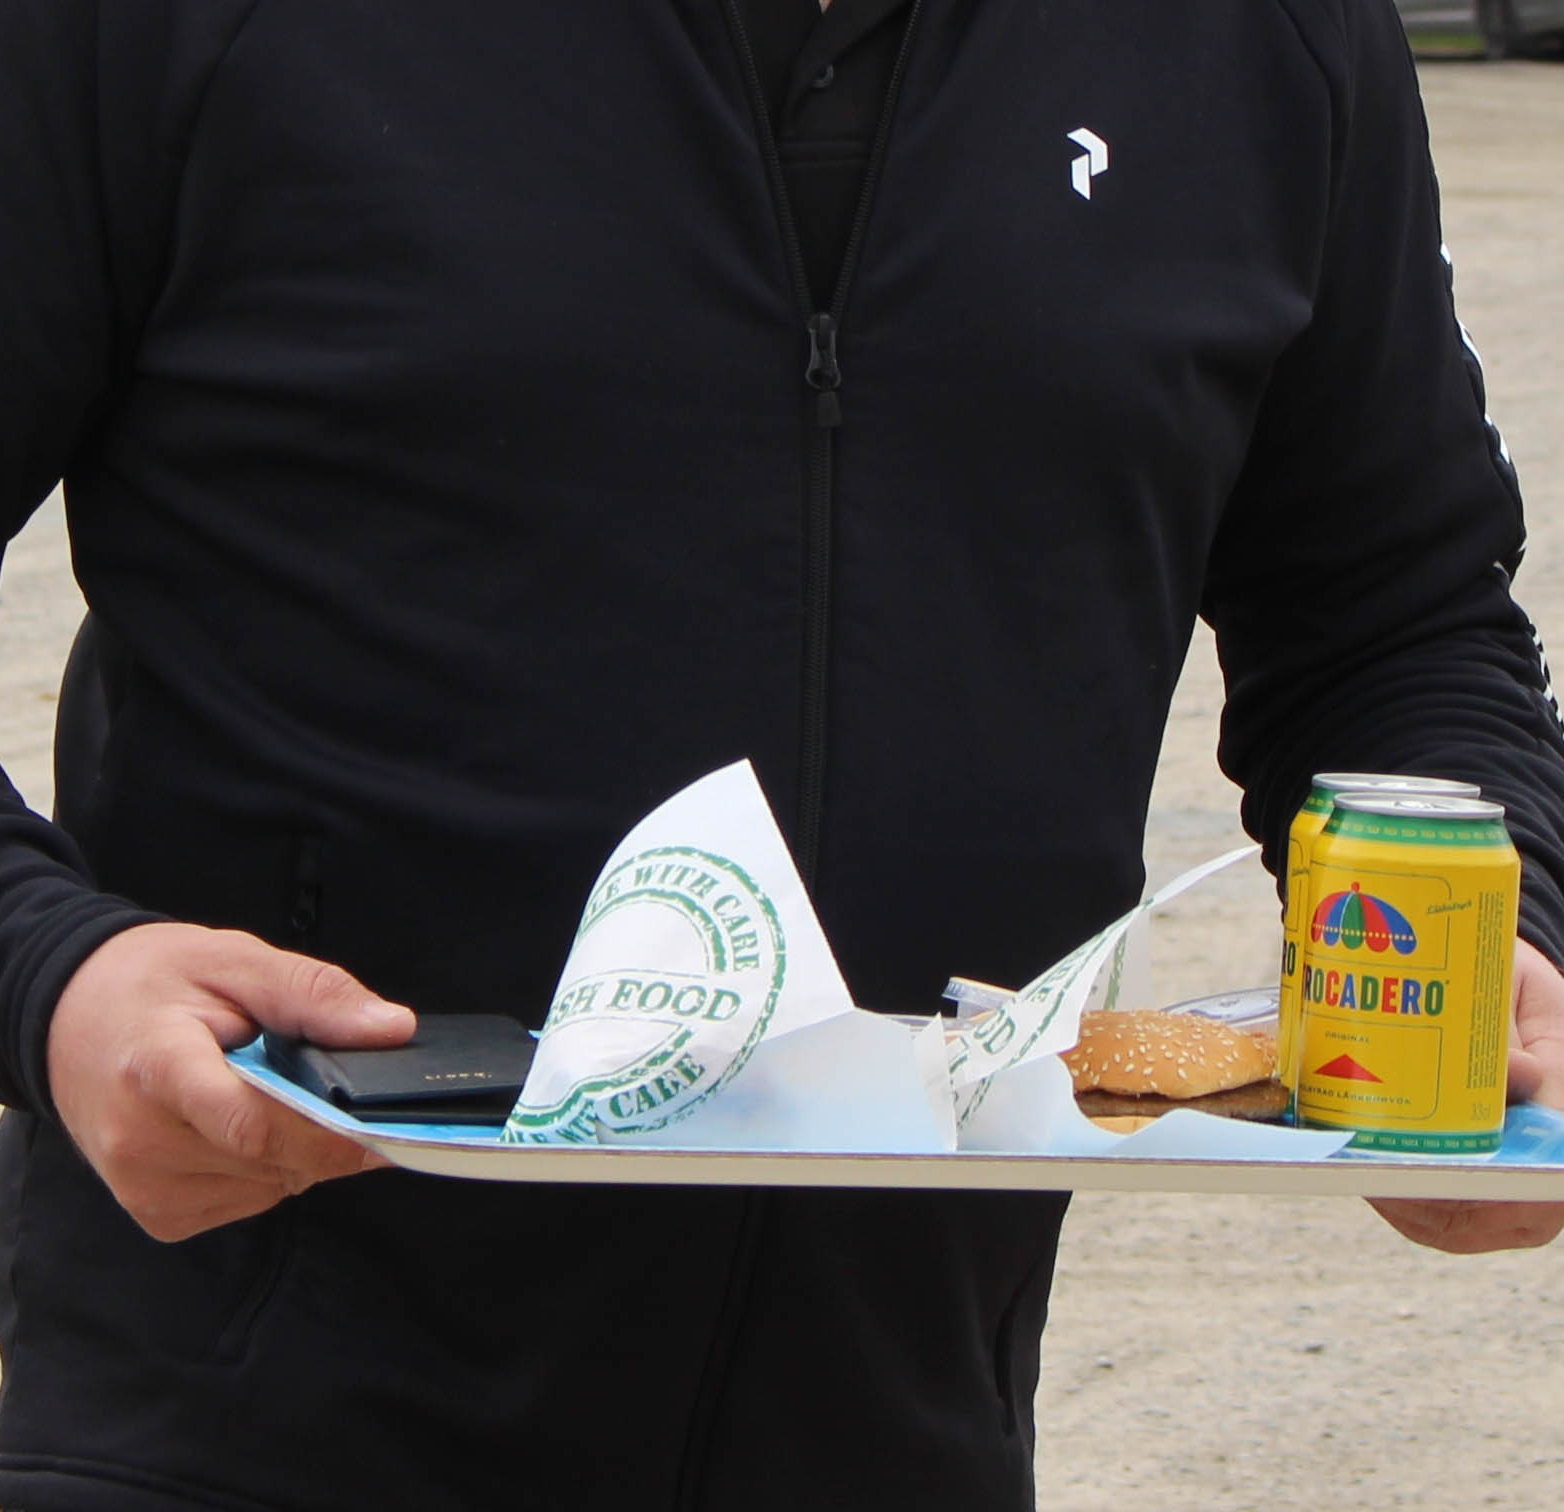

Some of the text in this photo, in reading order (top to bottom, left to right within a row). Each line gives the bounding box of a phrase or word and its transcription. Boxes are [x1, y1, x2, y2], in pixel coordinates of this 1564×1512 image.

[634, 863, 720, 899] WITH
[713, 894, 760, 972] CARE
[606, 978, 742, 1022] FOOD
[1303, 962, 1445, 1016] ROCADERO
[608, 1053, 706, 1120] CARE
